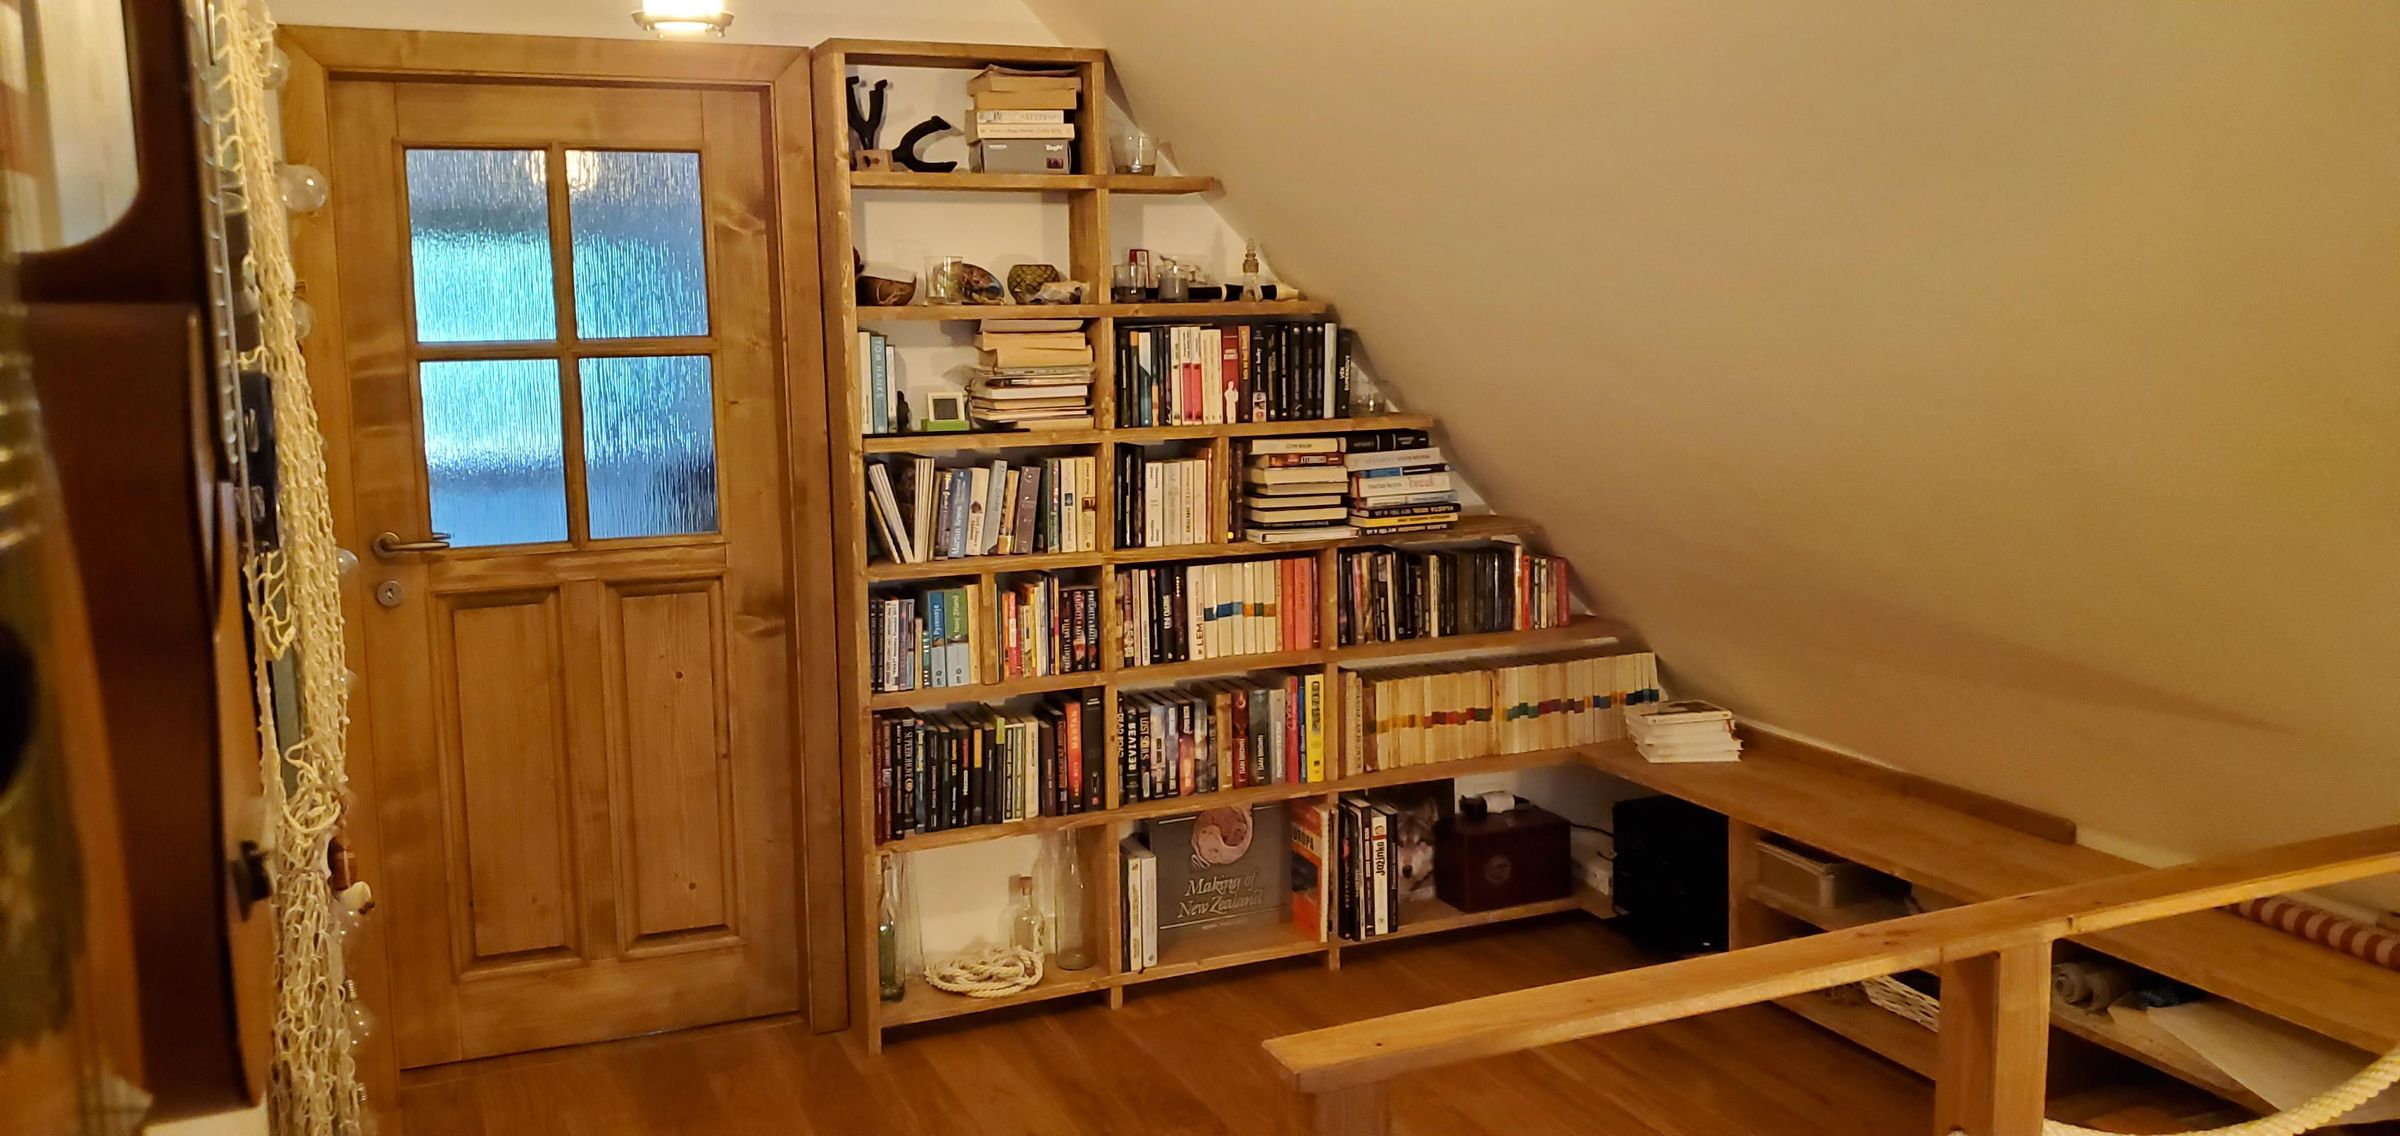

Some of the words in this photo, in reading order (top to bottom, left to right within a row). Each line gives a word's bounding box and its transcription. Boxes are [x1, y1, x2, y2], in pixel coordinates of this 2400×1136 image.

[875, 366, 884, 398] HANKS
[951, 528, 961, 554] Marian
[933, 604, 942, 635] Pyreneje
[953, 617, 962, 633] Nový
[1196, 622, 1204, 646] LEM
[1140, 717, 1150, 735] LOST
[1127, 722, 1137, 771] REVIVER
[1140, 735, 1150, 761] SOULS
[1238, 738, 1246, 761] BROWN
[1257, 734, 1265, 757] BROWN
[1292, 827, 1314, 851] UROPA
[1375, 841, 1386, 876] Jožinka
[1184, 875, 1241, 897] Making
[1244, 867, 1261, 890] of
[1177, 900, 1208, 918] New
[1209, 888, 1263, 915] Zealand
